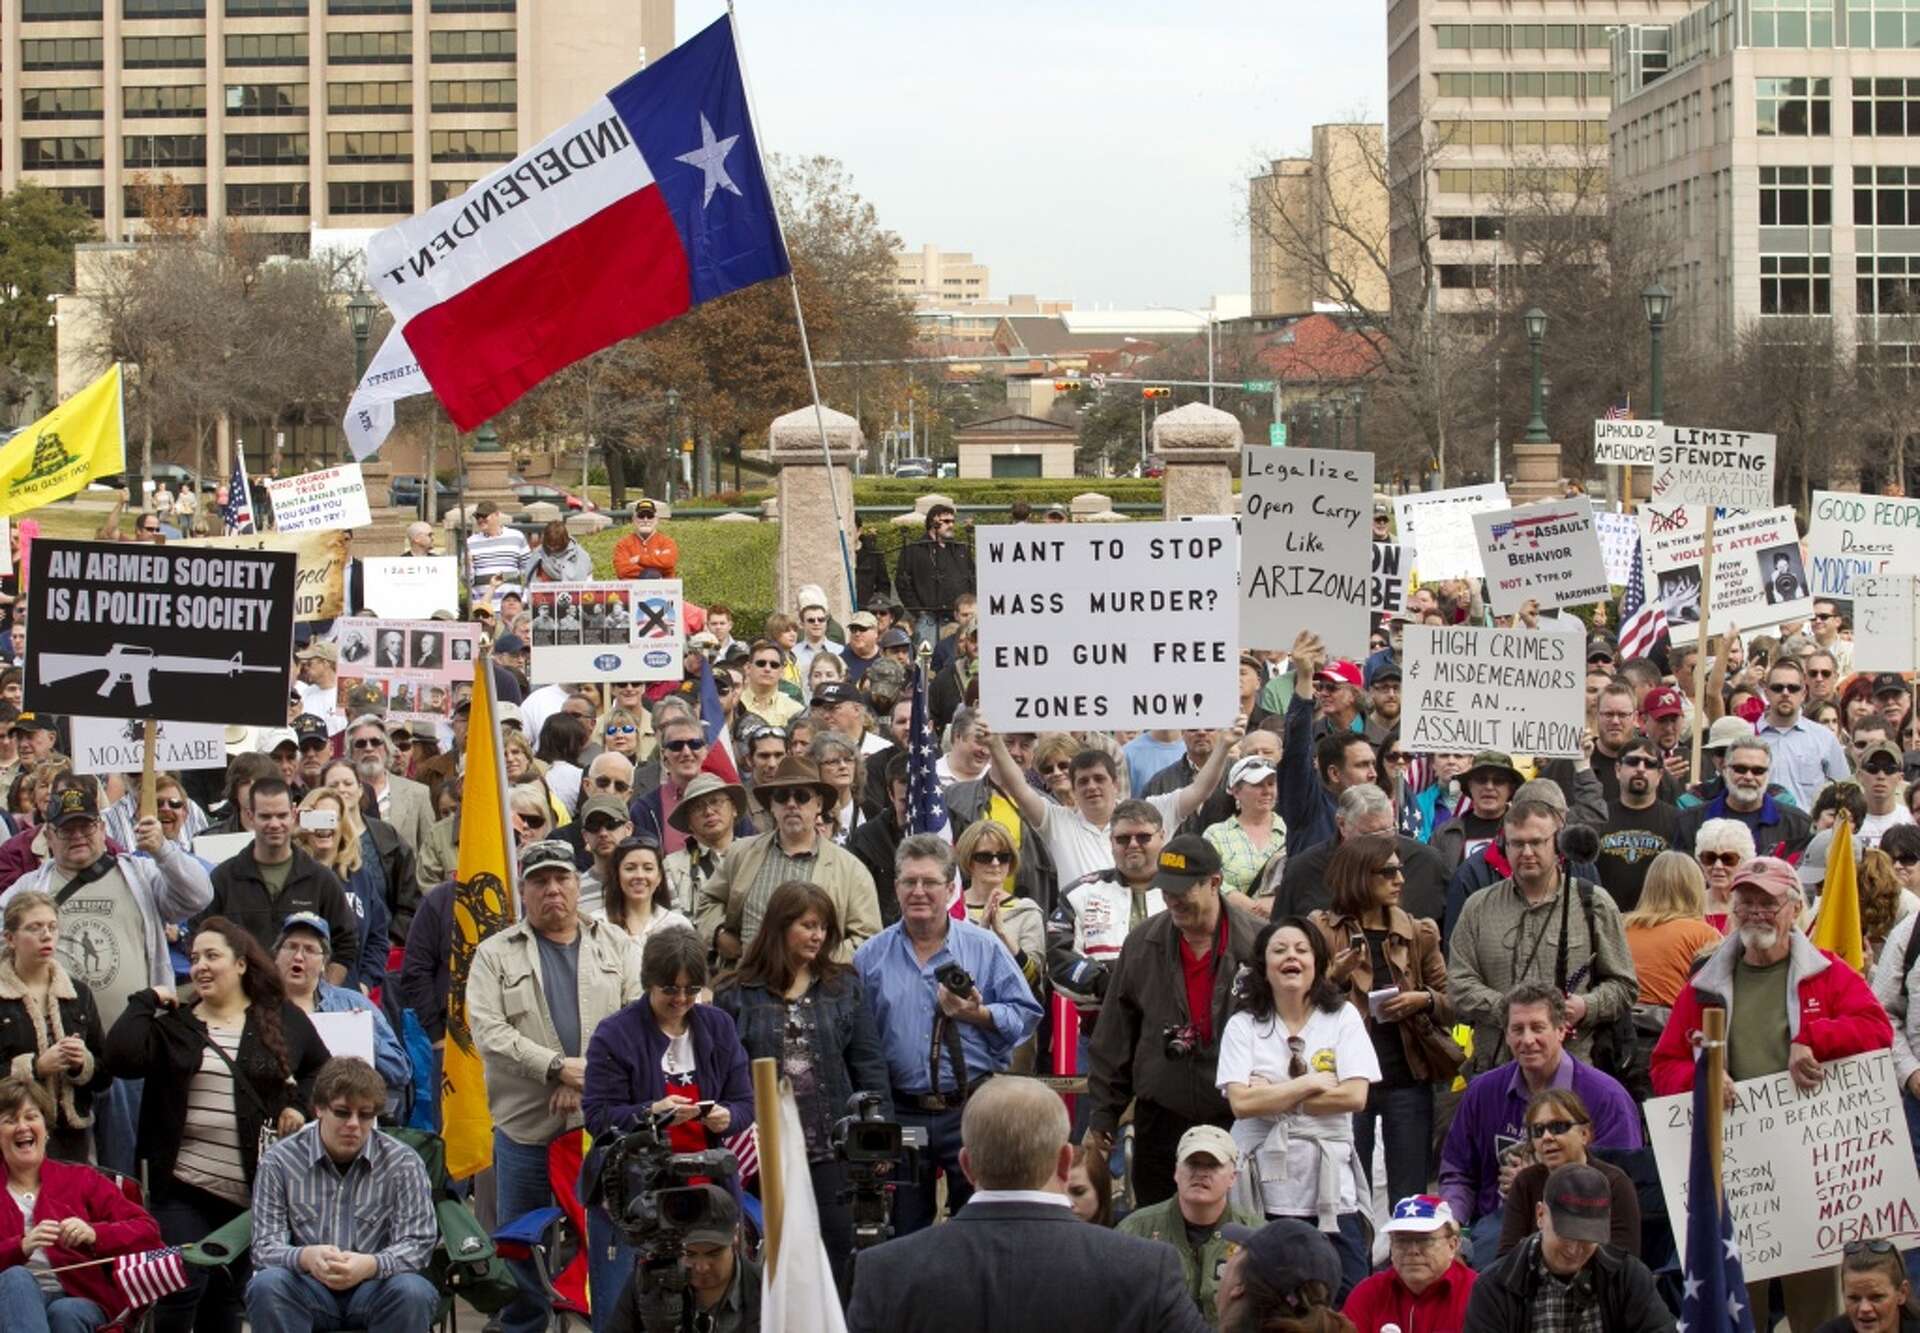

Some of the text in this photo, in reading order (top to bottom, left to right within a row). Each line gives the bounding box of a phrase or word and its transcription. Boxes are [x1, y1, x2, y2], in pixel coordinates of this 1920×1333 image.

[1597, 424, 1643, 438] UPHOLD
[1674, 429, 1751, 448] LIMIT
[1247, 451, 1359, 482] Legalize
[1659, 446, 1767, 471] SPENDING
[271, 479, 293, 490] KING
[296, 472, 331, 487] GEORGE
[296, 483, 325, 495] TRIED
[1679, 469, 1769, 488] MAGAZINE
[275, 495, 306, 510] SANTA
[309, 490, 336, 502] ANNA
[278, 500, 342, 521] YOU SURE YOU
[1247, 494, 1362, 529] Open Carry
[1818, 498, 1920, 528] GOOD PEOP
[308, 516, 321, 527] TO
[1535, 519, 1591, 539] ASSAULT
[1671, 537, 1691, 547] THE
[1738, 518, 1776, 532] BEFORE
[1780, 515, 1788, 523] A
[989, 537, 1223, 564] WANT TO STOP
[1729, 531, 1780, 551] ATTACK
[1841, 529, 1895, 553] Deserve
[1507, 547, 1573, 567] BEHAVIOR
[1718, 560, 1743, 572] HOW
[48, 551, 276, 590] AN ARMED SOCIETY
[1248, 565, 1367, 607] ARIZONA
[1499, 577, 1523, 591] NOT
[47, 588, 273, 632] IS A POLITE SOCIETY
[989, 589, 1218, 615] MASS MURDER?
[995, 641, 1227, 668] END GUN FREE
[1431, 629, 1565, 661] HIGH CRIMES
[1434, 661, 1576, 689] MISDEMEANORS
[1015, 692, 1204, 718] ZONES NOW!
[1421, 689, 1456, 708] ARE
[1413, 715, 1584, 751] ASSAULT WEAPON
[1786, 1101, 1832, 1125] BEAR
[1837, 1088, 1886, 1112] ARMS
[1802, 1105, 1897, 1145] AGAINST
[1812, 1128, 1895, 1167] HITLER
[1814, 1154, 1876, 1186] LENIN
[1816, 1168, 1884, 1201] STALIN
[1819, 1195, 1863, 1221] MAO
[1817, 1197, 1919, 1250] OBAMA
